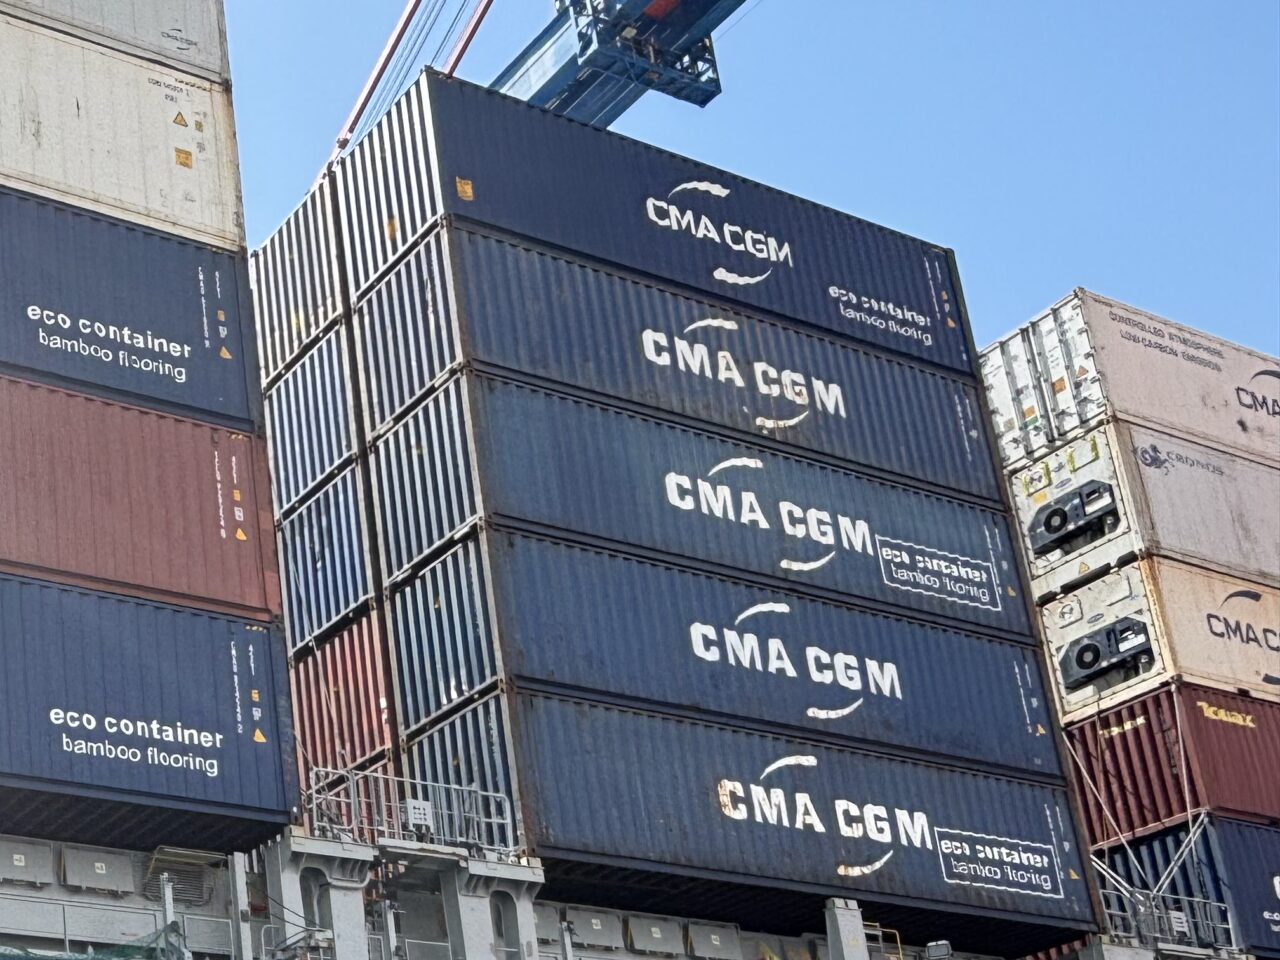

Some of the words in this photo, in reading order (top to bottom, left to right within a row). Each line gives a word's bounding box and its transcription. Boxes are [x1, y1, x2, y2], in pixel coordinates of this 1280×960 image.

[646, 197, 721, 243] CMA
[723, 222, 793, 267] CGM
[27, 305, 71, 329] eco
[78, 318, 192, 358] container
[828, 286, 857, 304] eco
[861, 296, 931, 327] container
[38, 328, 113, 362] bamboo
[118, 350, 186, 383] flooring
[642, 328, 745, 387] CMA
[753, 361, 846, 418] CGM
[664, 471, 771, 529] CMA
[778, 501, 874, 556] CGM
[881, 547, 910, 564] eco
[915, 555, 987, 583] container
[1206, 612, 1263, 649] CMA
[689, 622, 798, 677] CMA
[805, 646, 902, 700] CGM
[49, 708, 97, 730] eco
[104, 716, 224, 748] container
[62, 733, 141, 762] bamboo
[147, 746, 218, 777] flooring
[716, 779, 826, 833] CMA
[834, 799, 933, 850] CGM
[940, 839, 970, 856] eco
[975, 844, 1049, 868] container
